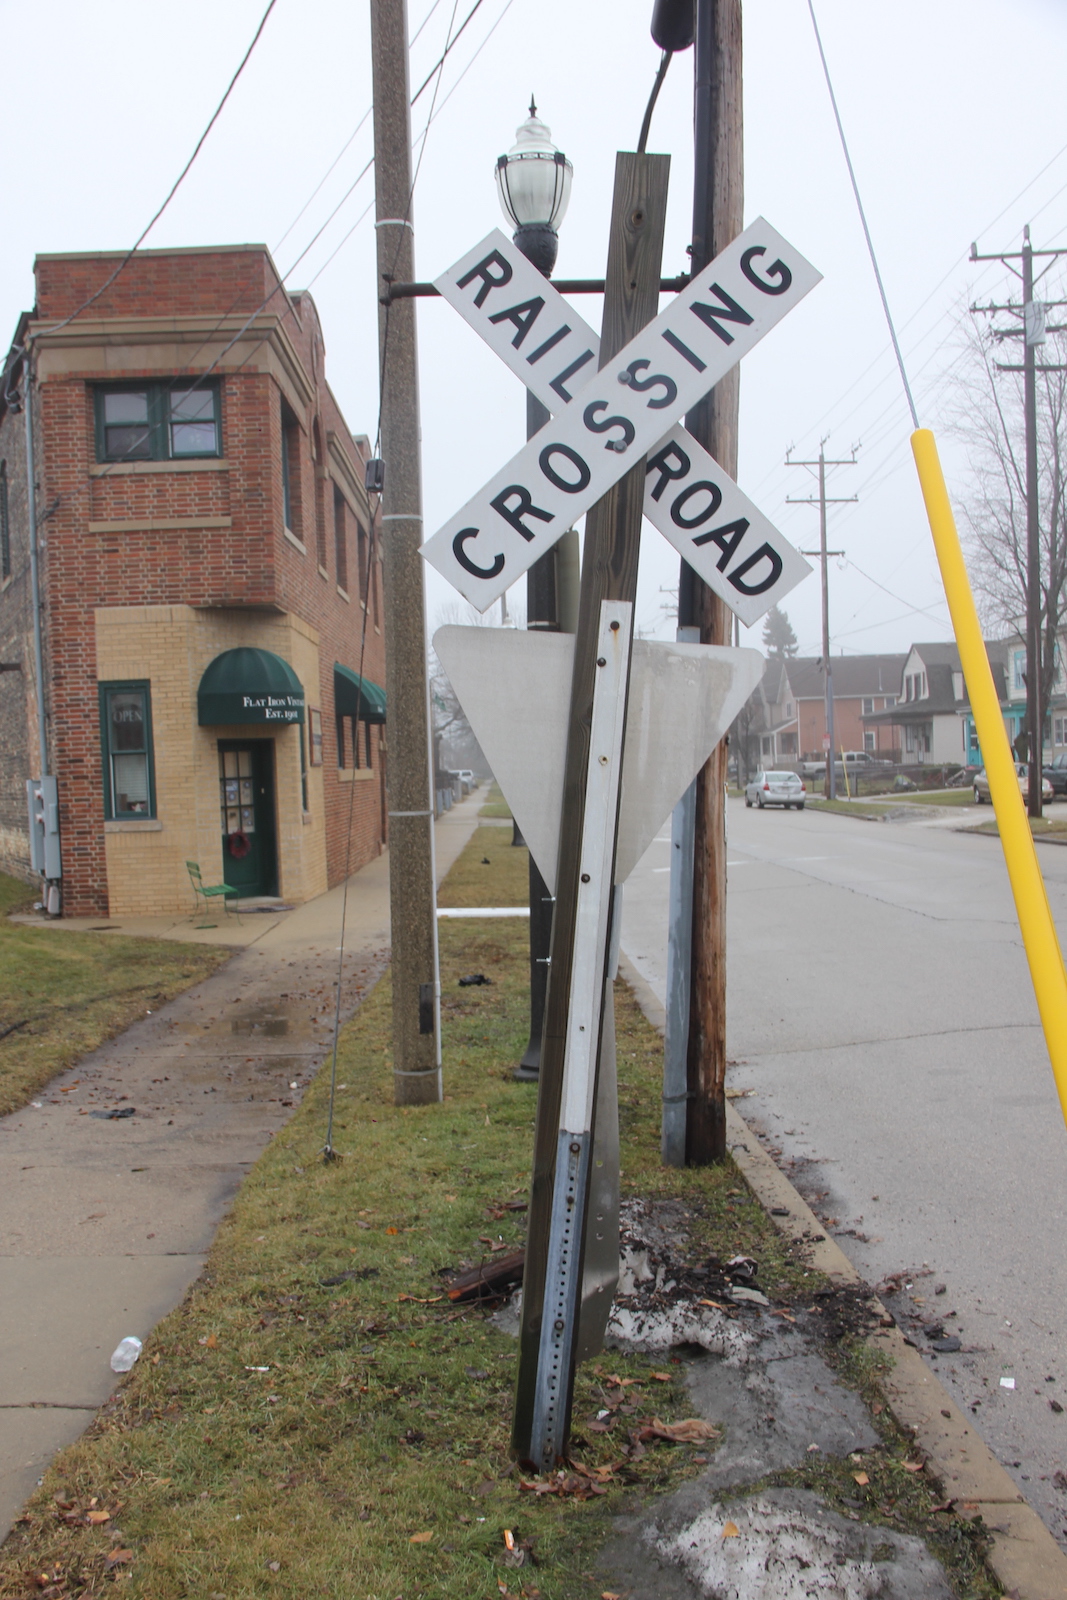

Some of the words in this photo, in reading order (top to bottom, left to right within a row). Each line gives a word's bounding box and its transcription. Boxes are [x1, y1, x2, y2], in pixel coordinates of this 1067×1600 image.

[452, 245, 793, 580] CROSSING
[456, 248, 595, 404] RAIL
[646, 440, 783, 596] ROAD
[113, 710, 142, 722] OPEN
[243, 696, 266, 707] FLAT
